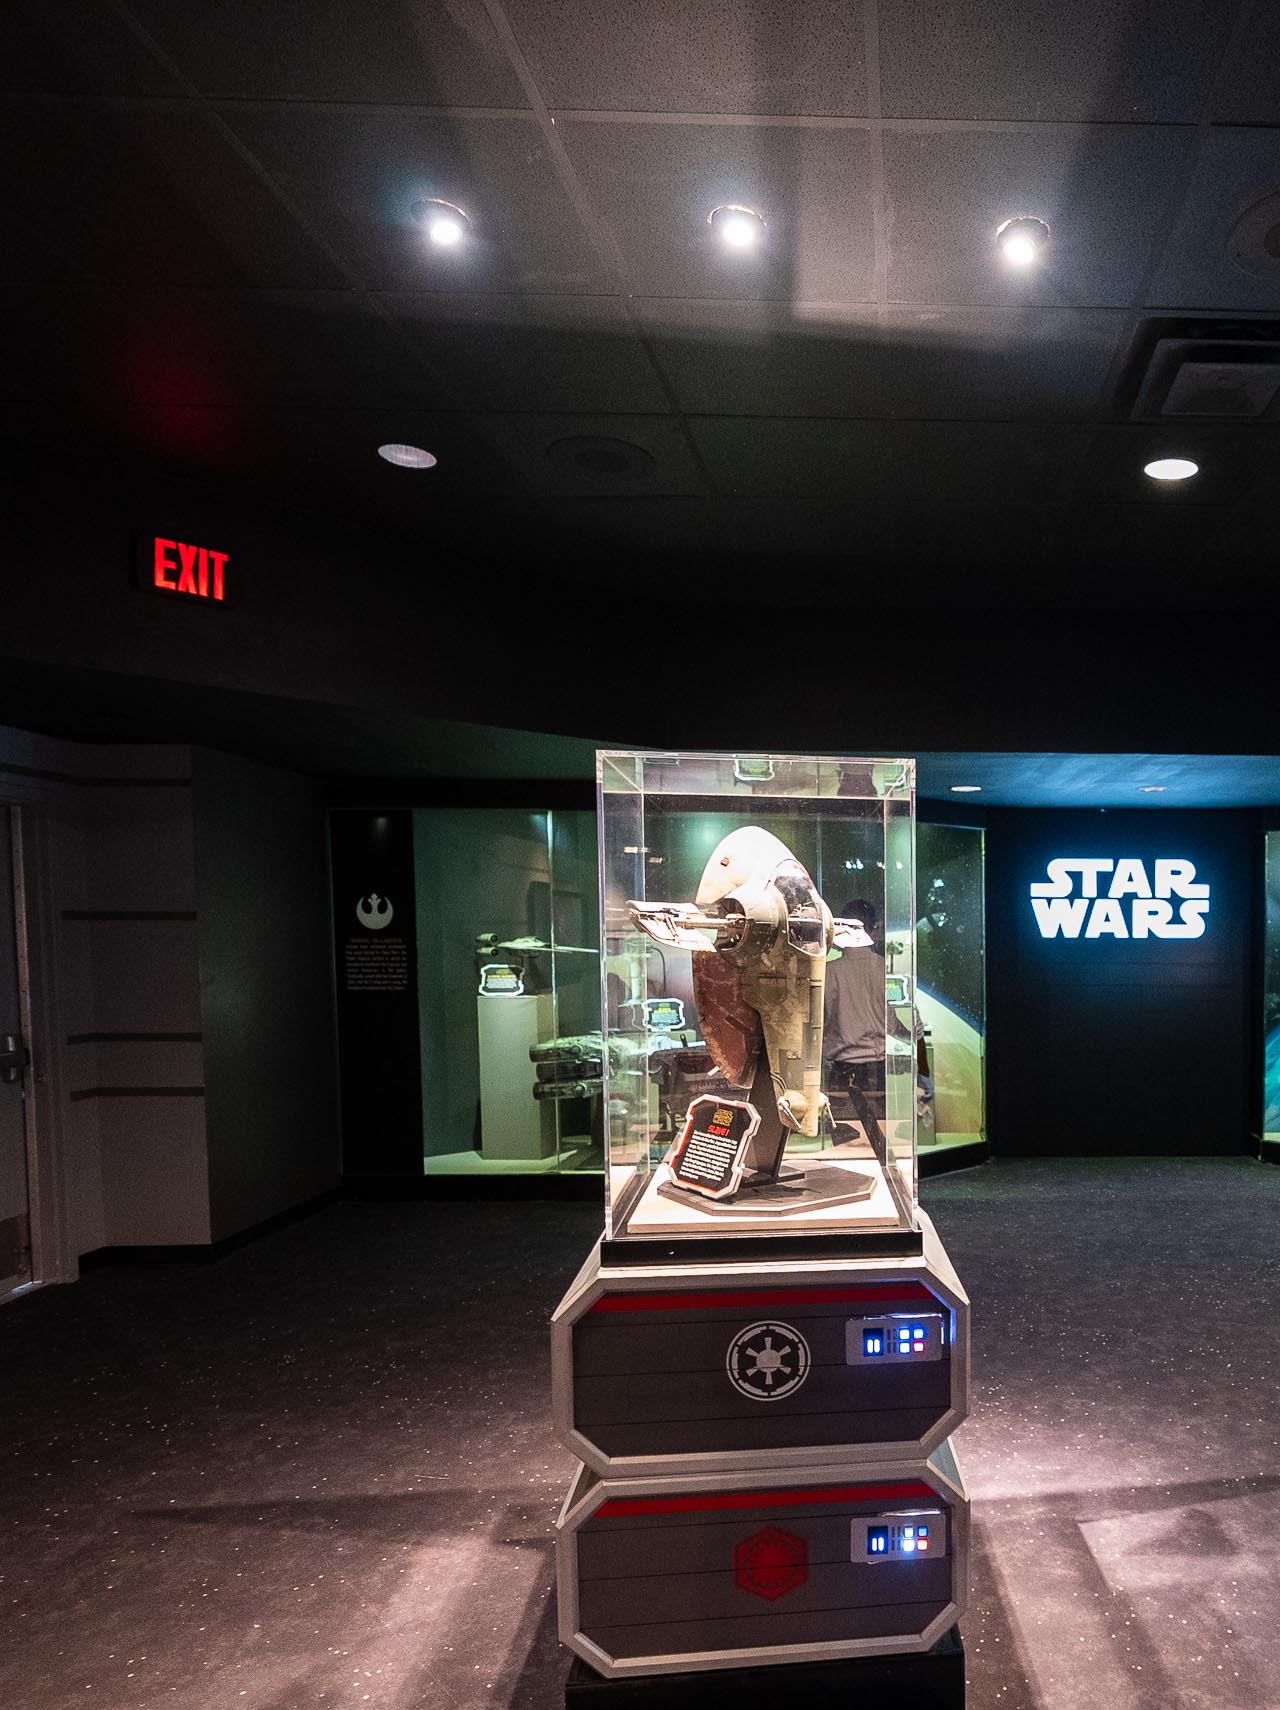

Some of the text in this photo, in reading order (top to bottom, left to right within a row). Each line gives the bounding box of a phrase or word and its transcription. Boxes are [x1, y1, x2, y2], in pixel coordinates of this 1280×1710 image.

[154, 537, 229, 600] EXIT
[1030, 858, 1210, 899] STAR
[1030, 898, 1210, 939] WARS
